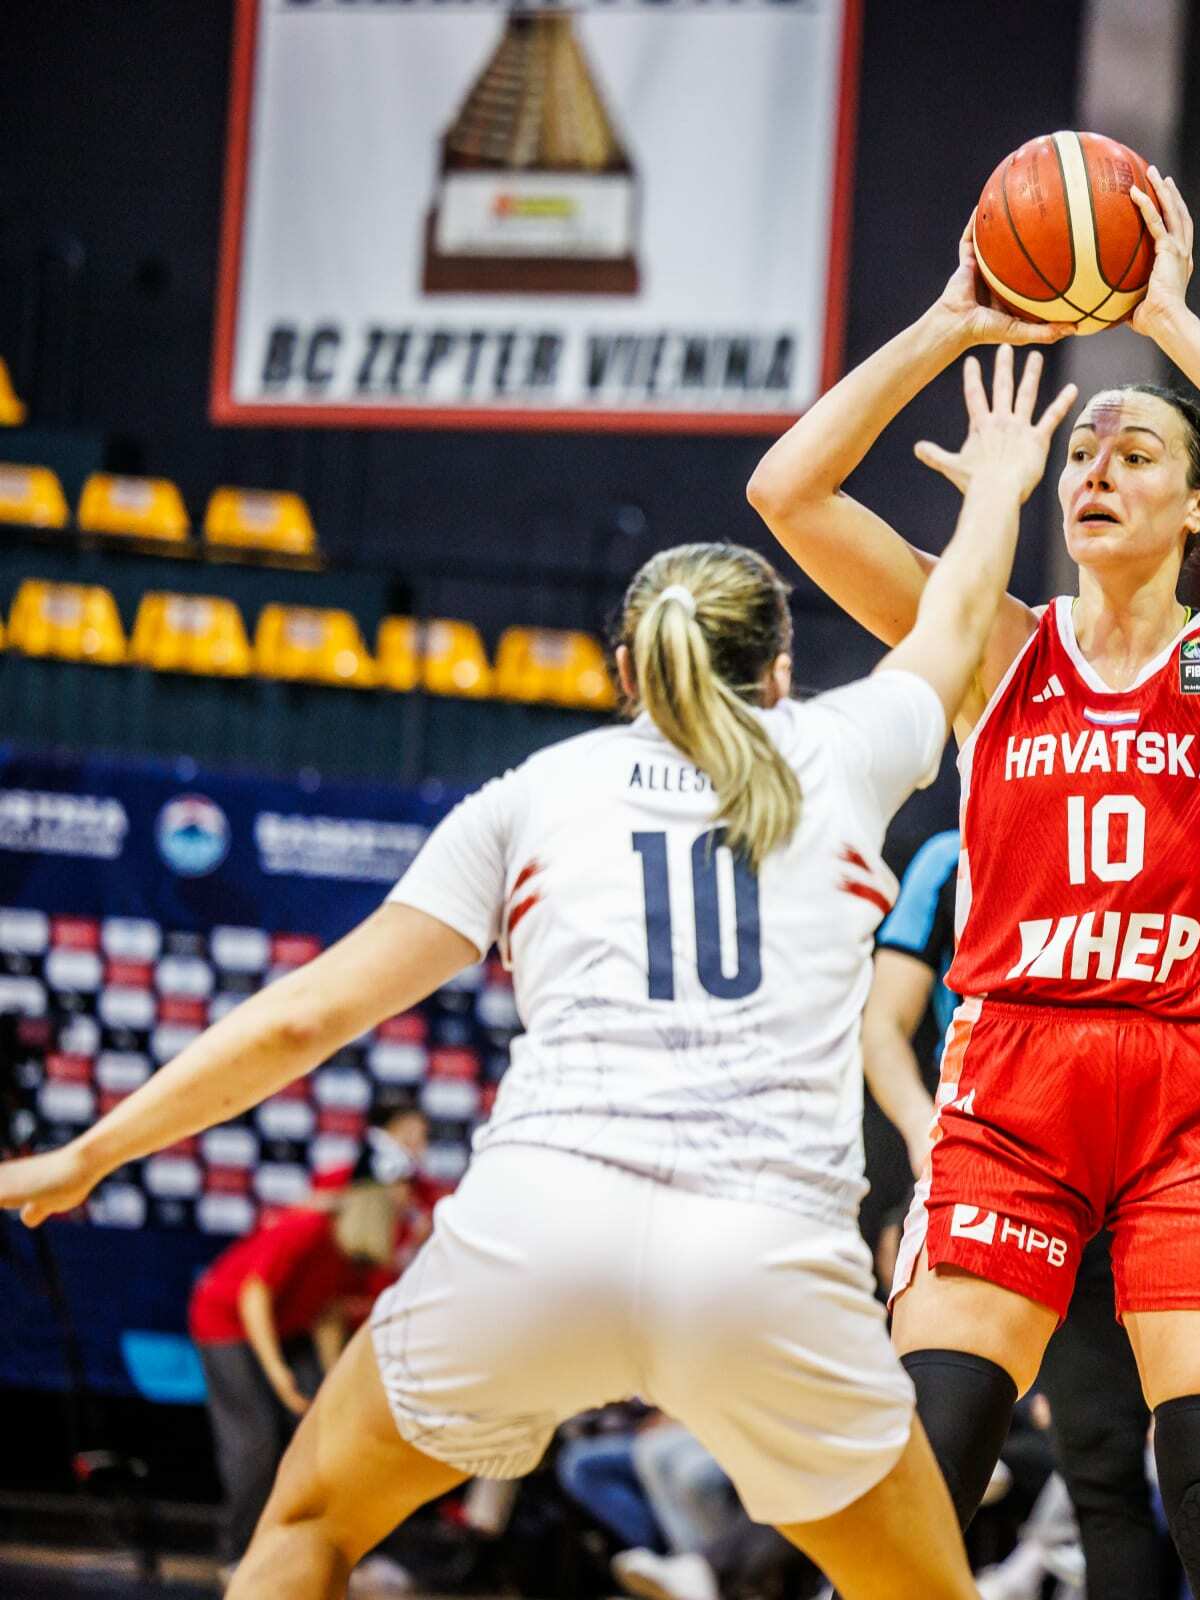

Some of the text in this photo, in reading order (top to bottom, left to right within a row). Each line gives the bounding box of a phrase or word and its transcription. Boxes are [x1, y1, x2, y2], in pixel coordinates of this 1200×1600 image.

[261, 323, 797, 392] BC ZEPTER VIENNA
[629, 763, 717, 792] ALLES
[1067, 794, 1146, 886] 10
[632, 827, 762, 1001] 10
[1070, 911, 1200, 984] HEP
[1001, 1217, 1067, 1267] HPB
